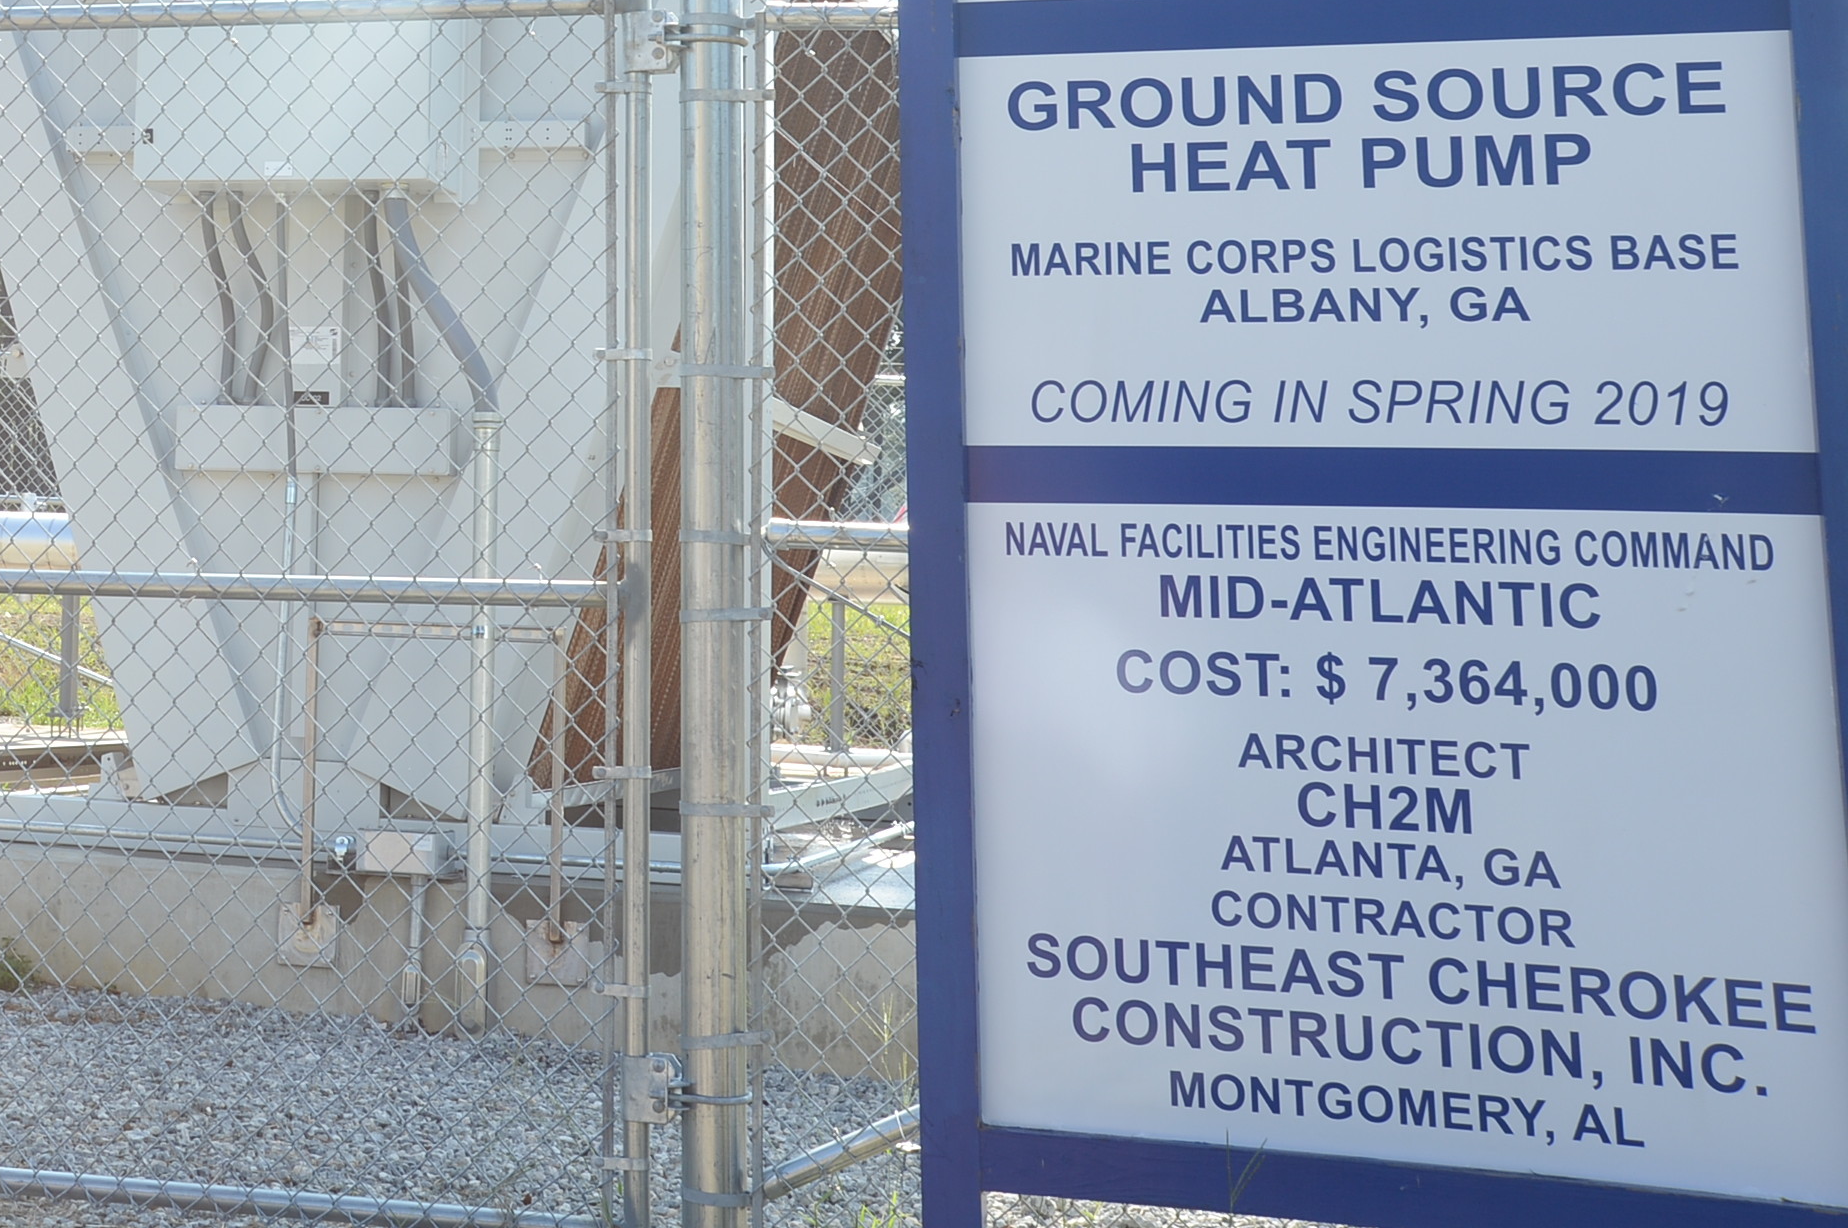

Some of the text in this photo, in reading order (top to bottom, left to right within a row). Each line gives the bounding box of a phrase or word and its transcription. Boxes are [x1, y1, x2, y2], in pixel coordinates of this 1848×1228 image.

[1008, 62, 1725, 130] GROUND SOURCE
[1132, 134, 1590, 192] HEAT PUMP
[1012, 234, 1738, 276] MARINE CORPS LOGISTICS BASE
[1200, 287, 1530, 328] ALBANY, GA
[1032, 380, 1728, 426] COMING IN SPRING 2019
[1006, 522, 1773, 570] NAVAL FACILITIES ENGINEERING COMMAND
[1160, 575, 1600, 628] MID-ATLANTIC
[1118, 650, 1656, 715] COST: $ 7,364,000
[1239, 733, 1529, 779] ARCHITECT
[1298, 782, 1471, 834] CH2M
[1221, 836, 1561, 890] ATLANTA, GA
[1212, 891, 1575, 948] CONTRACTOR
[1028, 933, 1816, 1034] SOUTHEAST CHEROKEE
[1073, 997, 1767, 1096] CONSTRUCTION, INC.
[1171, 1071, 1644, 1147] MONTGOMERY, AL
